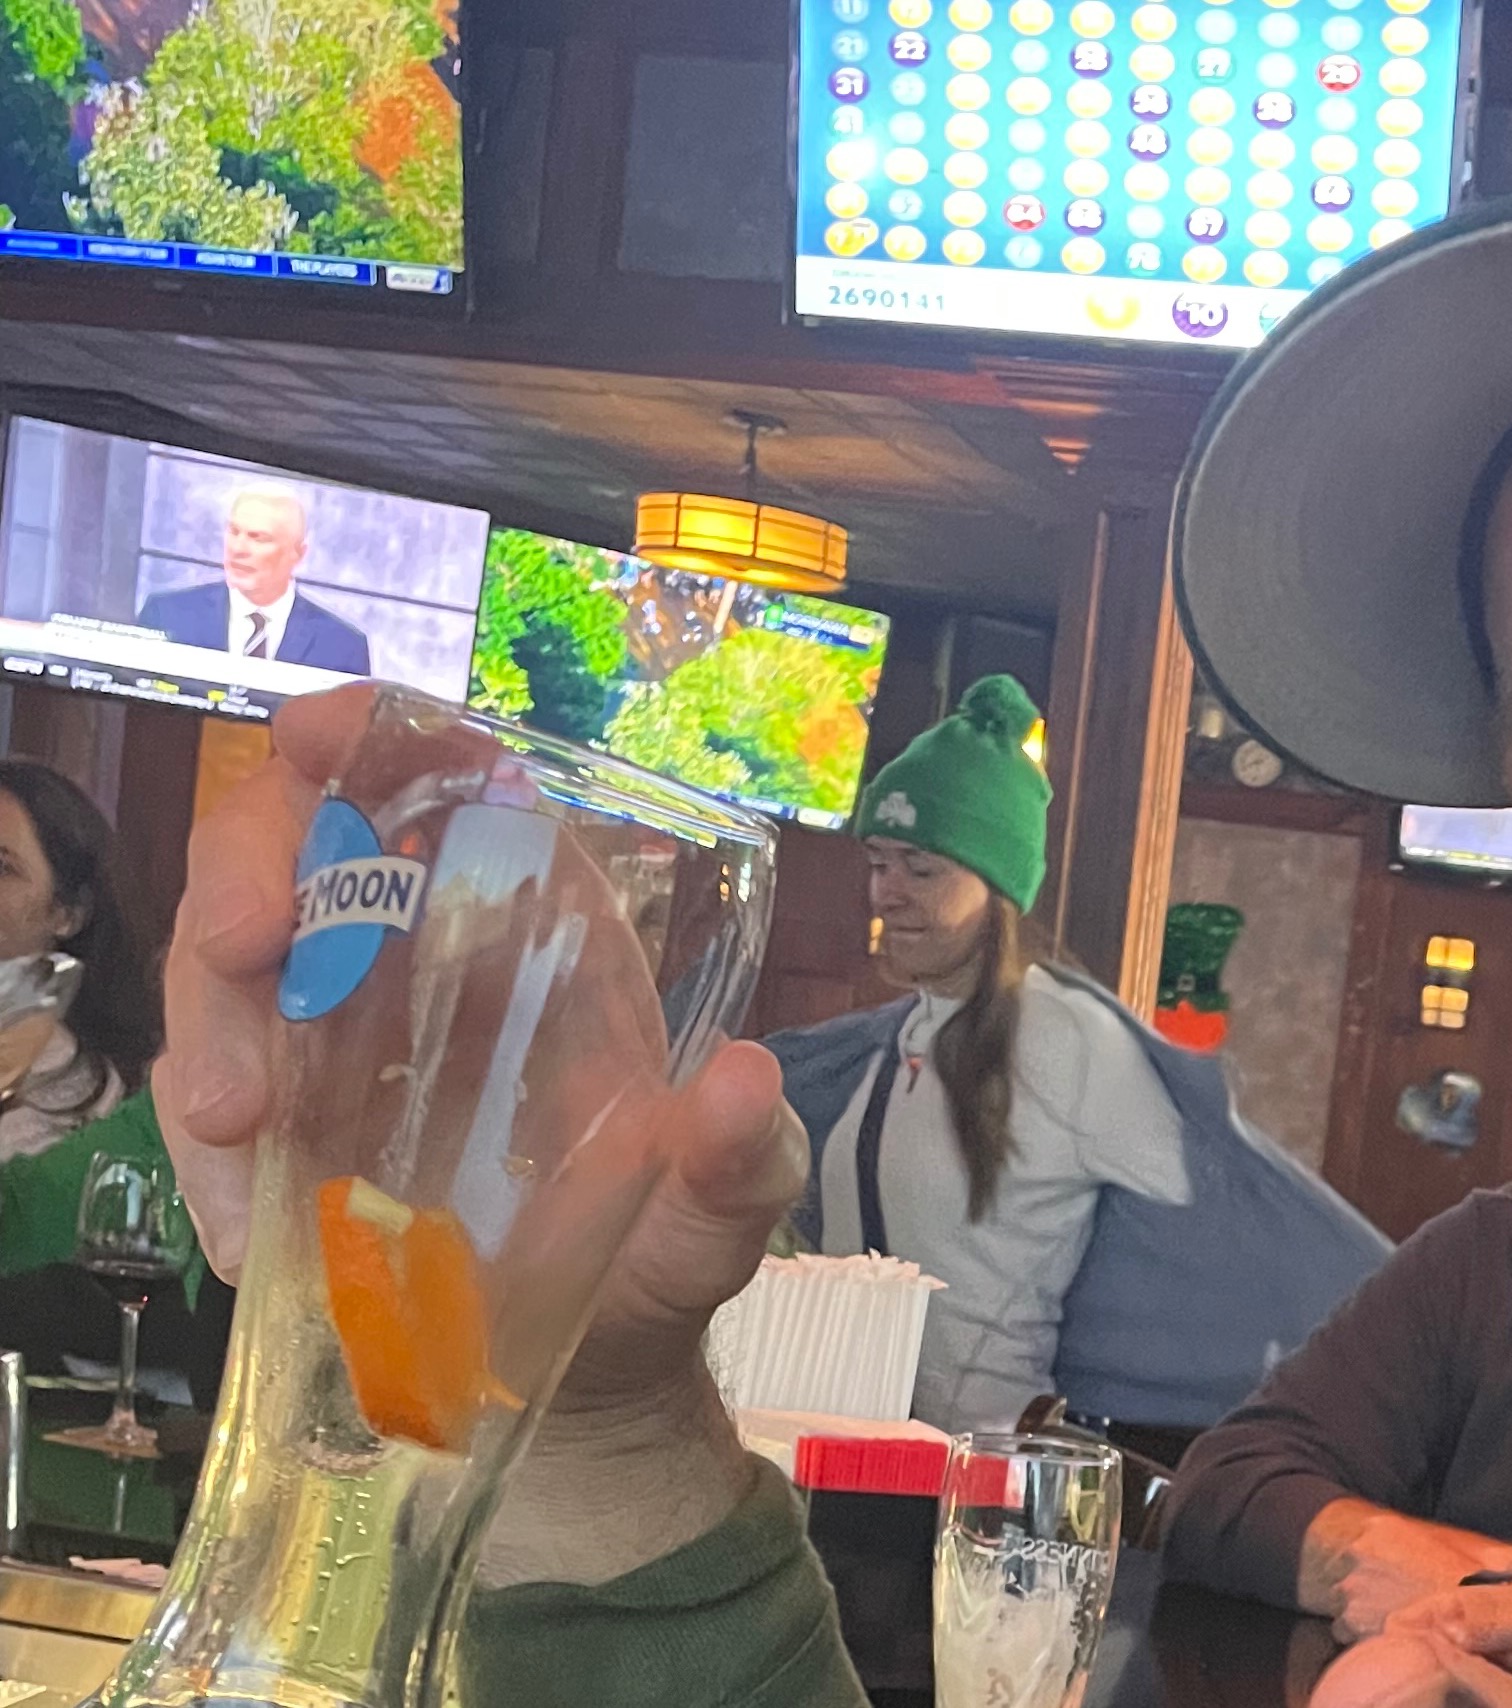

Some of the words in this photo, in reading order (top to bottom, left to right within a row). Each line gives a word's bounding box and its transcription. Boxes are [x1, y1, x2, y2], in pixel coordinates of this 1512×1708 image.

[836, 75, 863, 96] 31
[827, 284, 943, 310] 2690141
[310, 870, 413, 921] MOON
